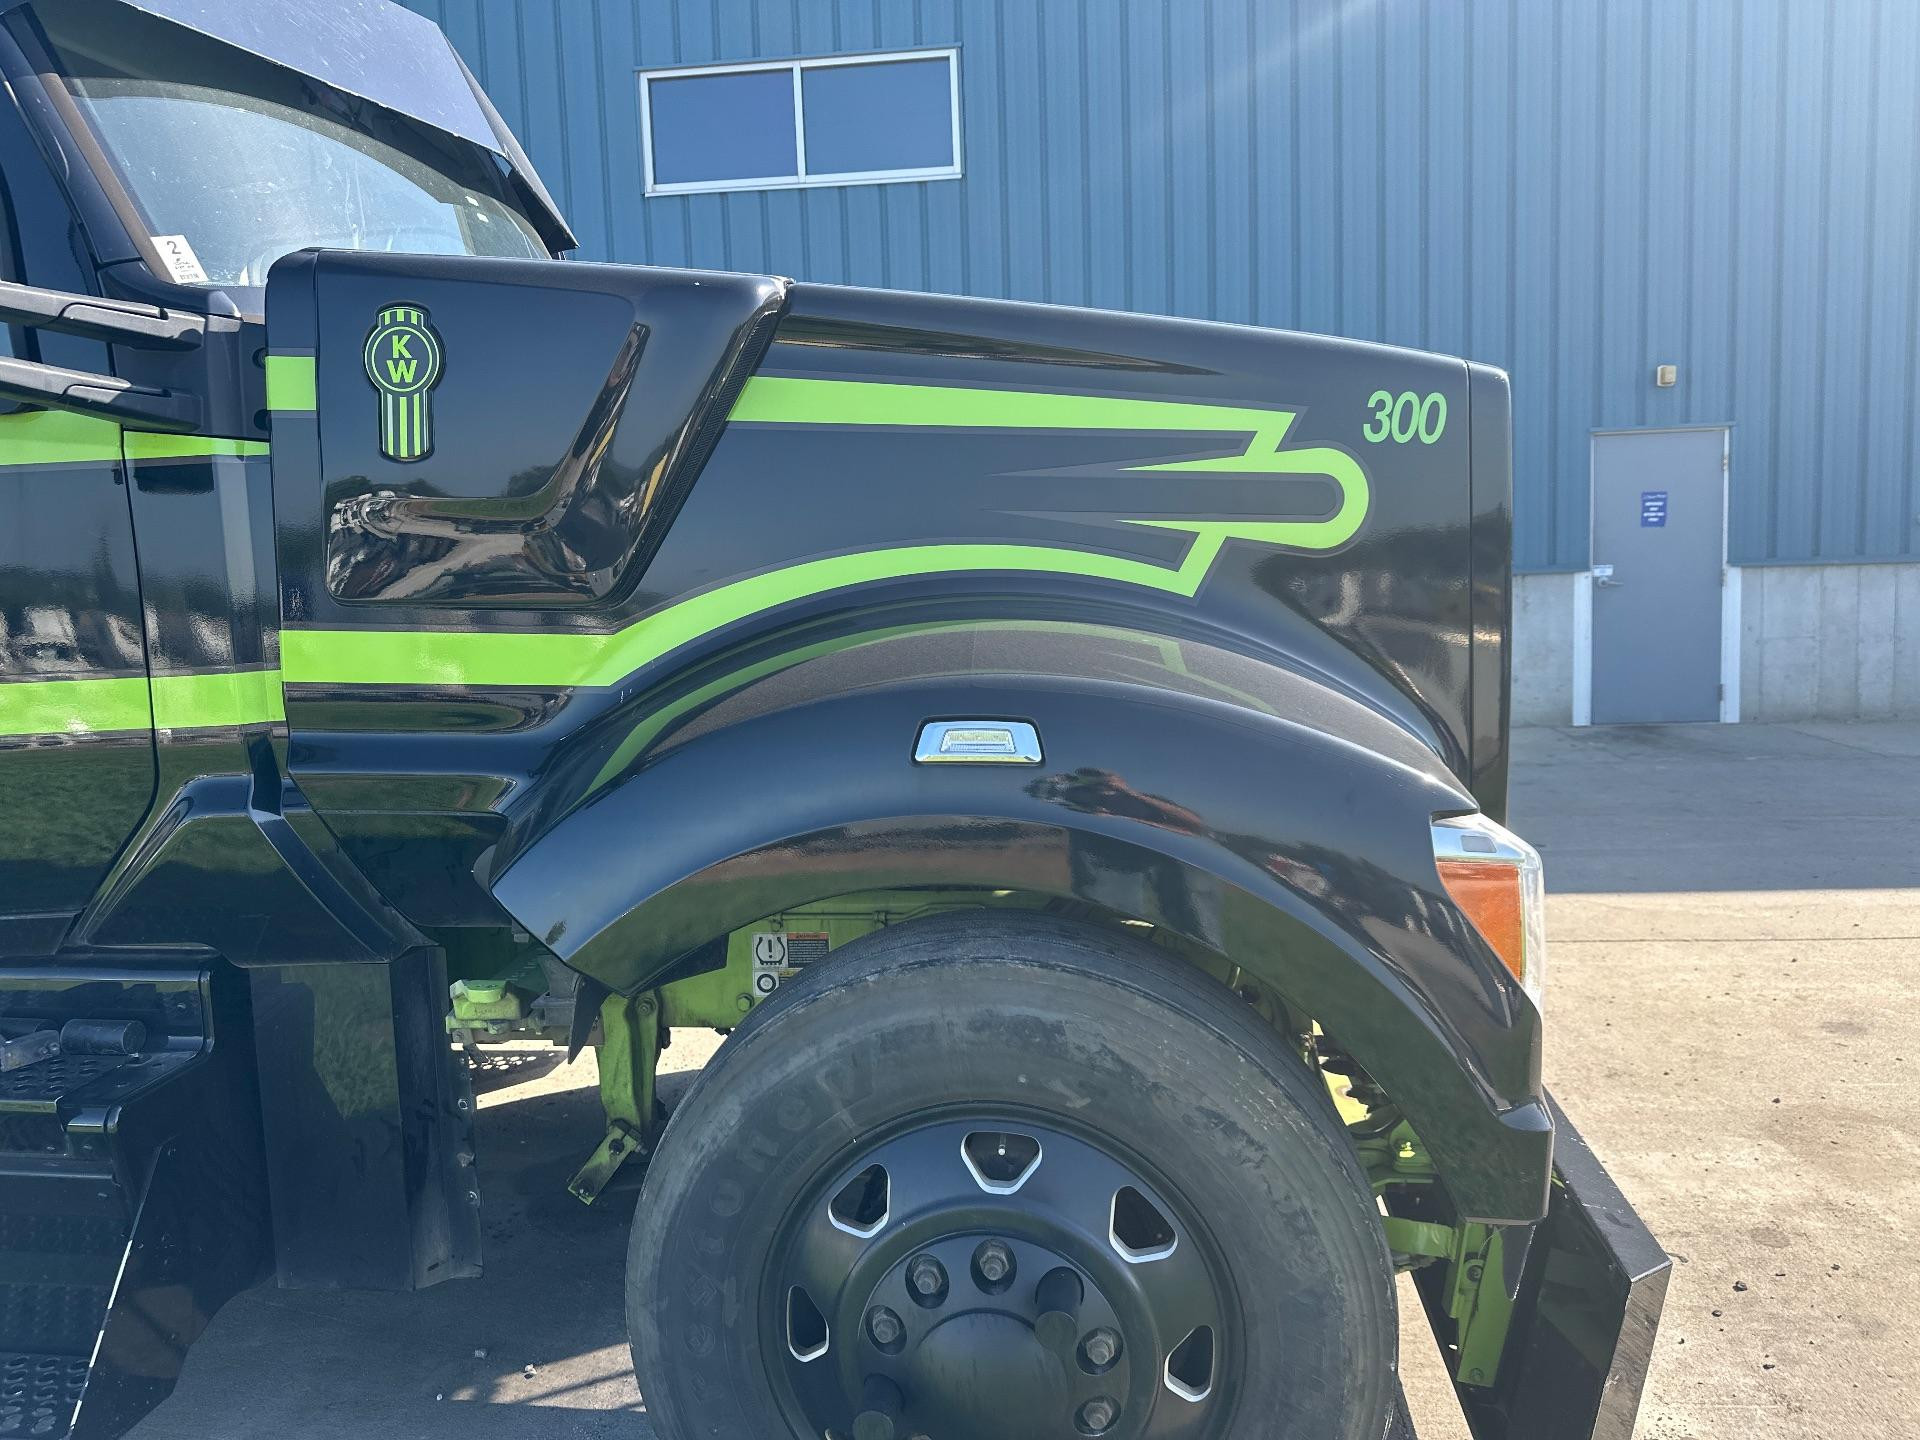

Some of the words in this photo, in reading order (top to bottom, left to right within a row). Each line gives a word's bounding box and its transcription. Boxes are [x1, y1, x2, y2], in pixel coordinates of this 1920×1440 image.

[166, 240, 182, 255] 2
[392, 334, 413, 359] K
[386, 359, 418, 384] W
[1363, 390, 1448, 445] 300
